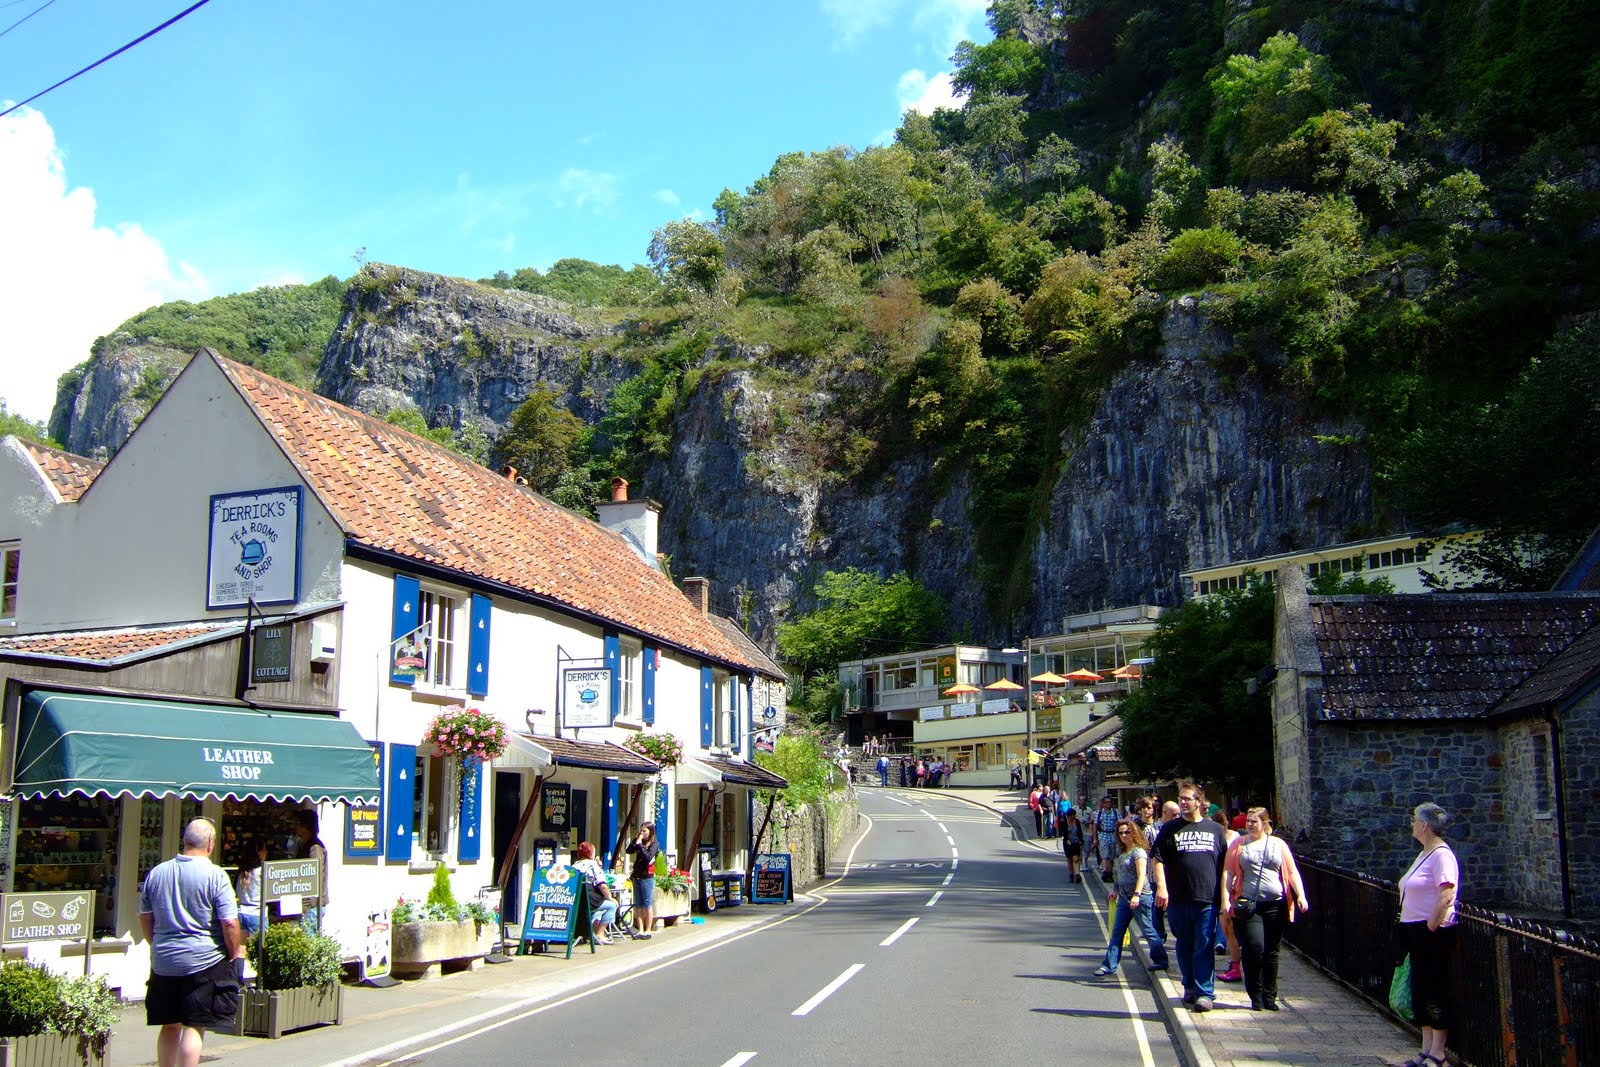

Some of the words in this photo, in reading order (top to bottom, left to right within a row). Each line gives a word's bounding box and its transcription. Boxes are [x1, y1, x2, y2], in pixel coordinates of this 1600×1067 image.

[221, 501, 286, 523] DERRICK'S
[230, 525, 248, 545] TEA
[250, 522, 279, 543] ROOMS
[233, 563, 252, 580] AND
[253, 555, 273, 579] SHOP
[265, 628, 284, 639] LILY
[256, 666, 289, 677] COTTAGE
[567, 671, 609, 682] DERRICK'S
[202, 747, 275, 765] LEATHER
[221, 764, 262, 780] SHOP
[1174, 831, 1215, 843] MILNER
[268, 866, 299, 882] Gorgeous
[300, 863, 317, 877] Gifts
[272, 881, 291, 895] Great
[292, 879, 312, 893] Prices
[539, 883, 572, 895] BEAUTIFUL
[532, 891, 546, 903] TEA
[547, 893, 577, 906] GARDEN!
[11, 924, 55, 939] LEATHER
[57, 923, 82, 936] SHOP
